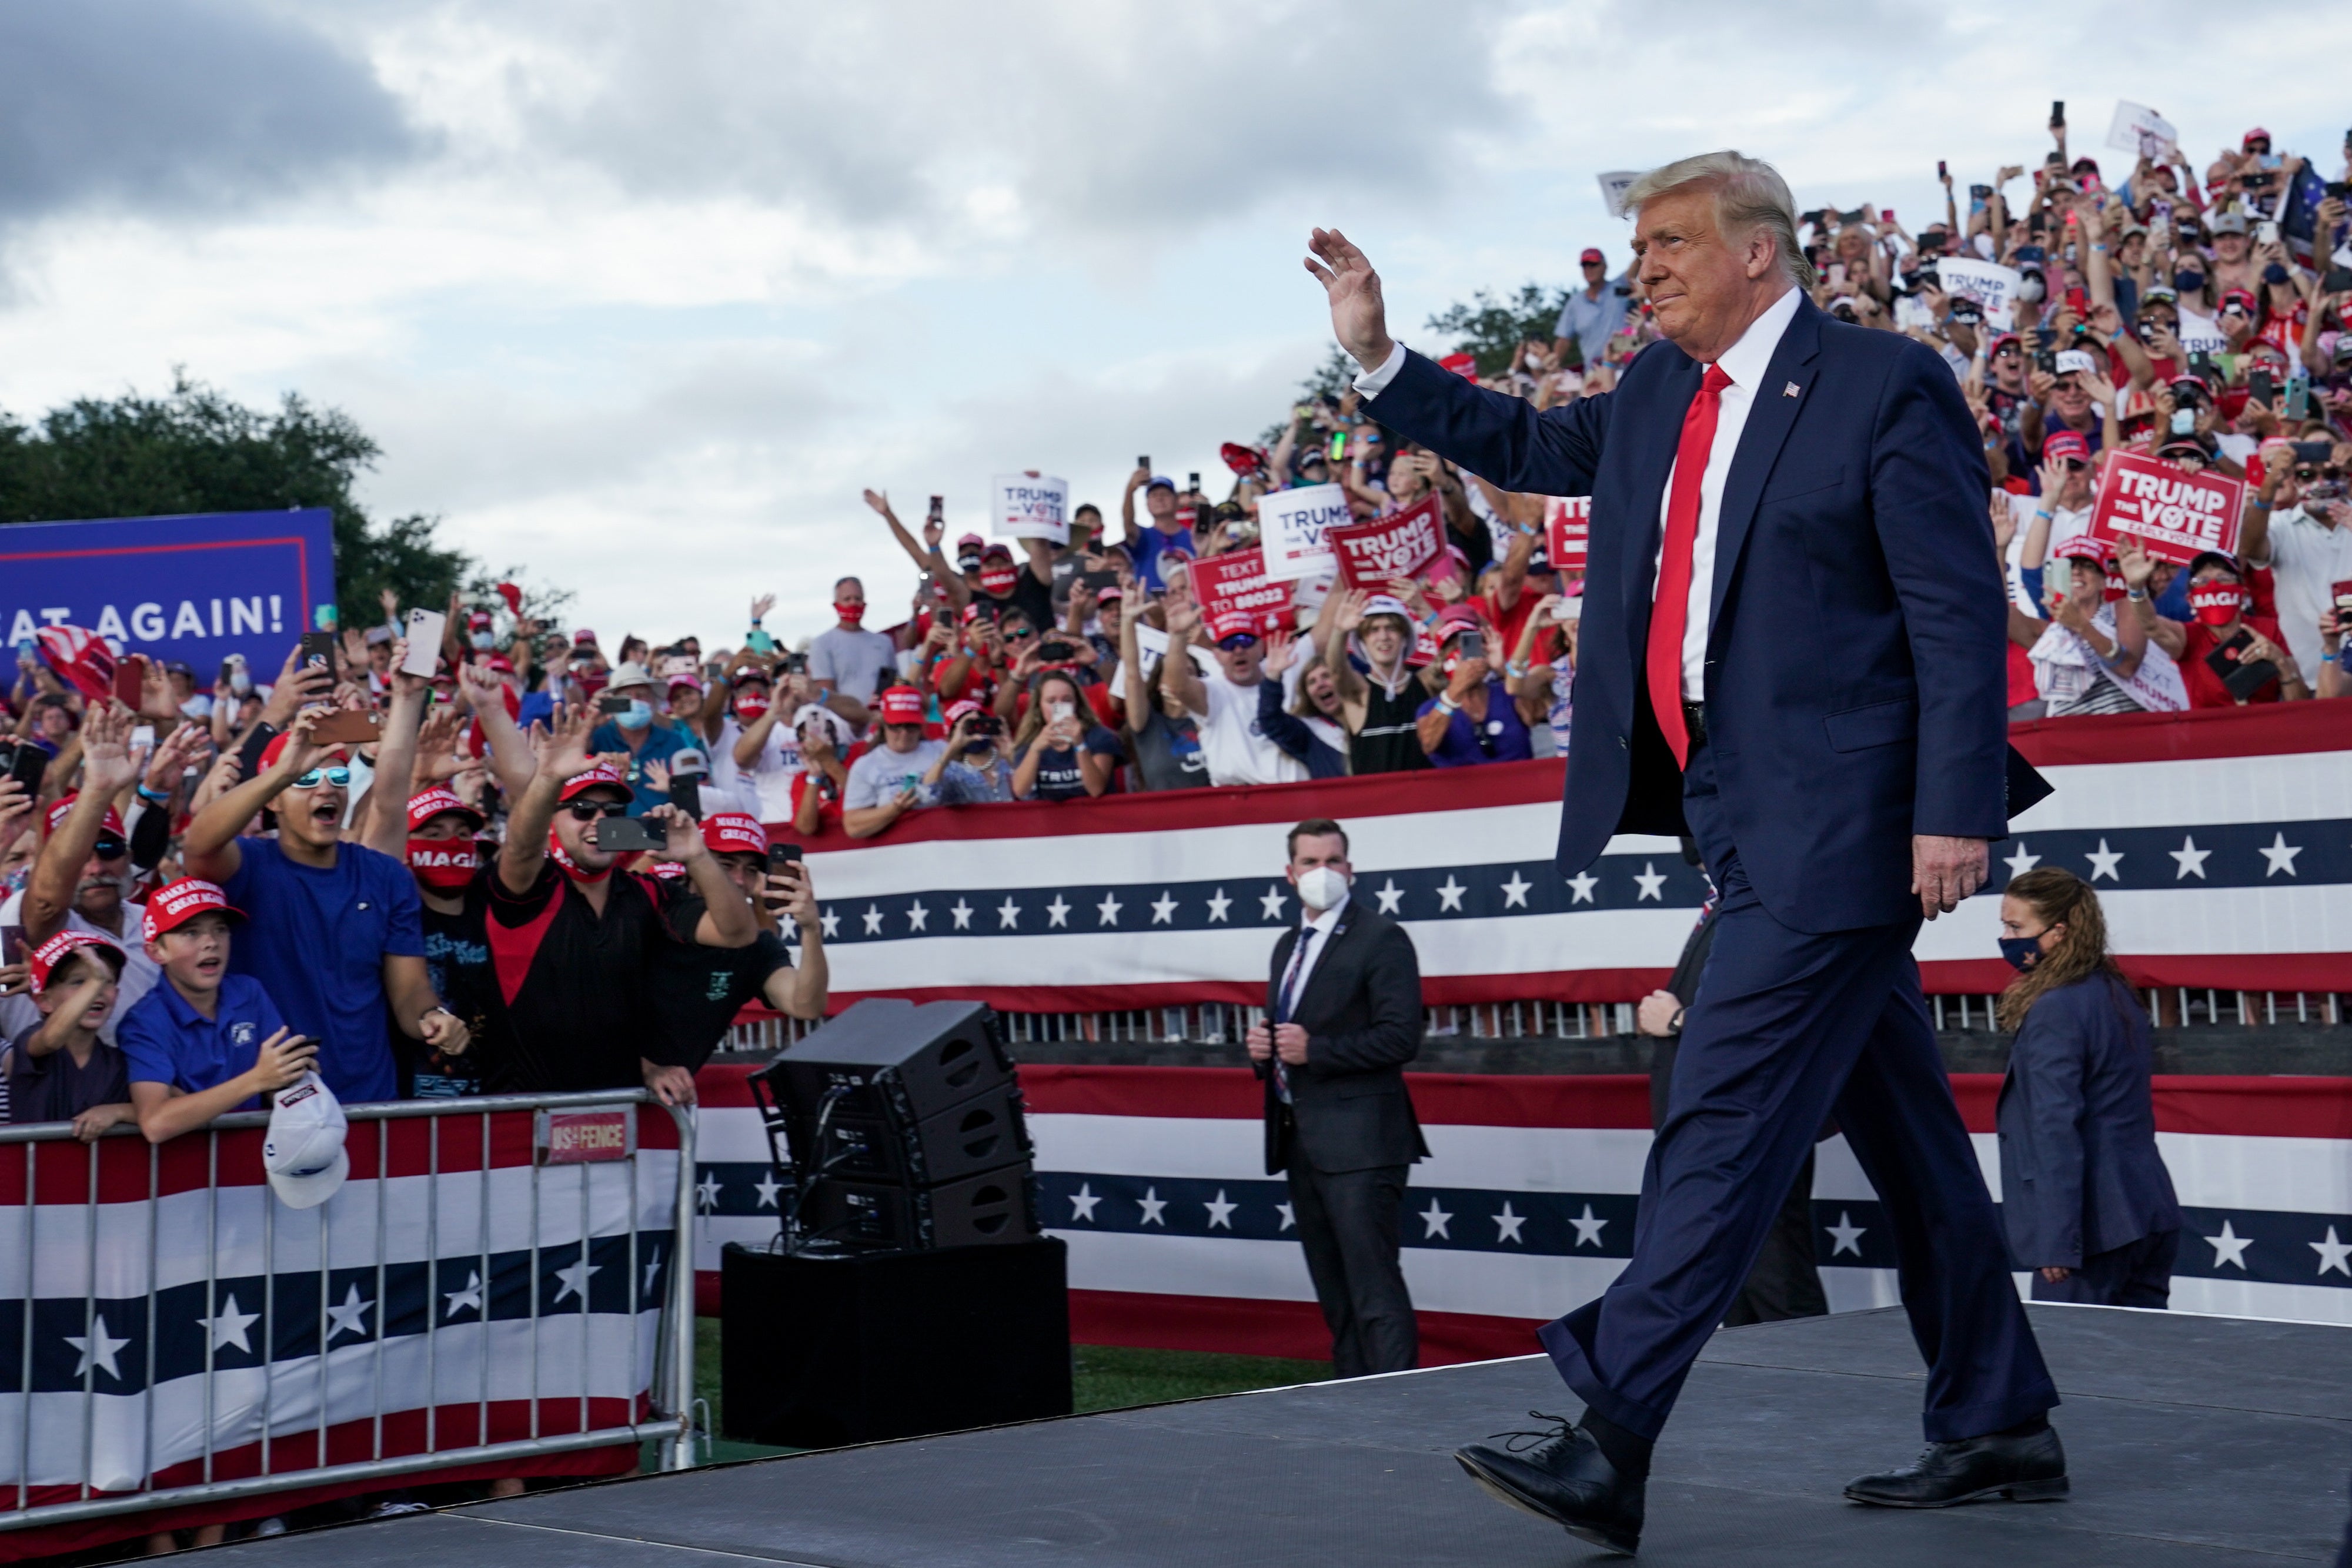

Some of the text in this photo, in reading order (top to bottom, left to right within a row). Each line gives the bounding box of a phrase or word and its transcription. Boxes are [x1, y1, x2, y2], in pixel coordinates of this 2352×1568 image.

[1947, 273, 2004, 290] TRUMP
[1005, 487, 1062, 503] TRUMP
[2117, 468, 2227, 514] TRUMP
[2114, 499, 2224, 541] THE VOTE
[2129, 523, 2198, 544] EARLY VOTE
[1342, 511, 1432, 557] TRUMP
[1371, 527, 1435, 570] VOTE
[1219, 559, 1258, 579] TEXT
[96, 594, 283, 642] AGAIN!
[1209, 598, 1233, 614] TO
[2141, 663, 2171, 690] EXT
[2133, 676, 2181, 713] RUMP
[580, 1124, 624, 1148] FENCE
